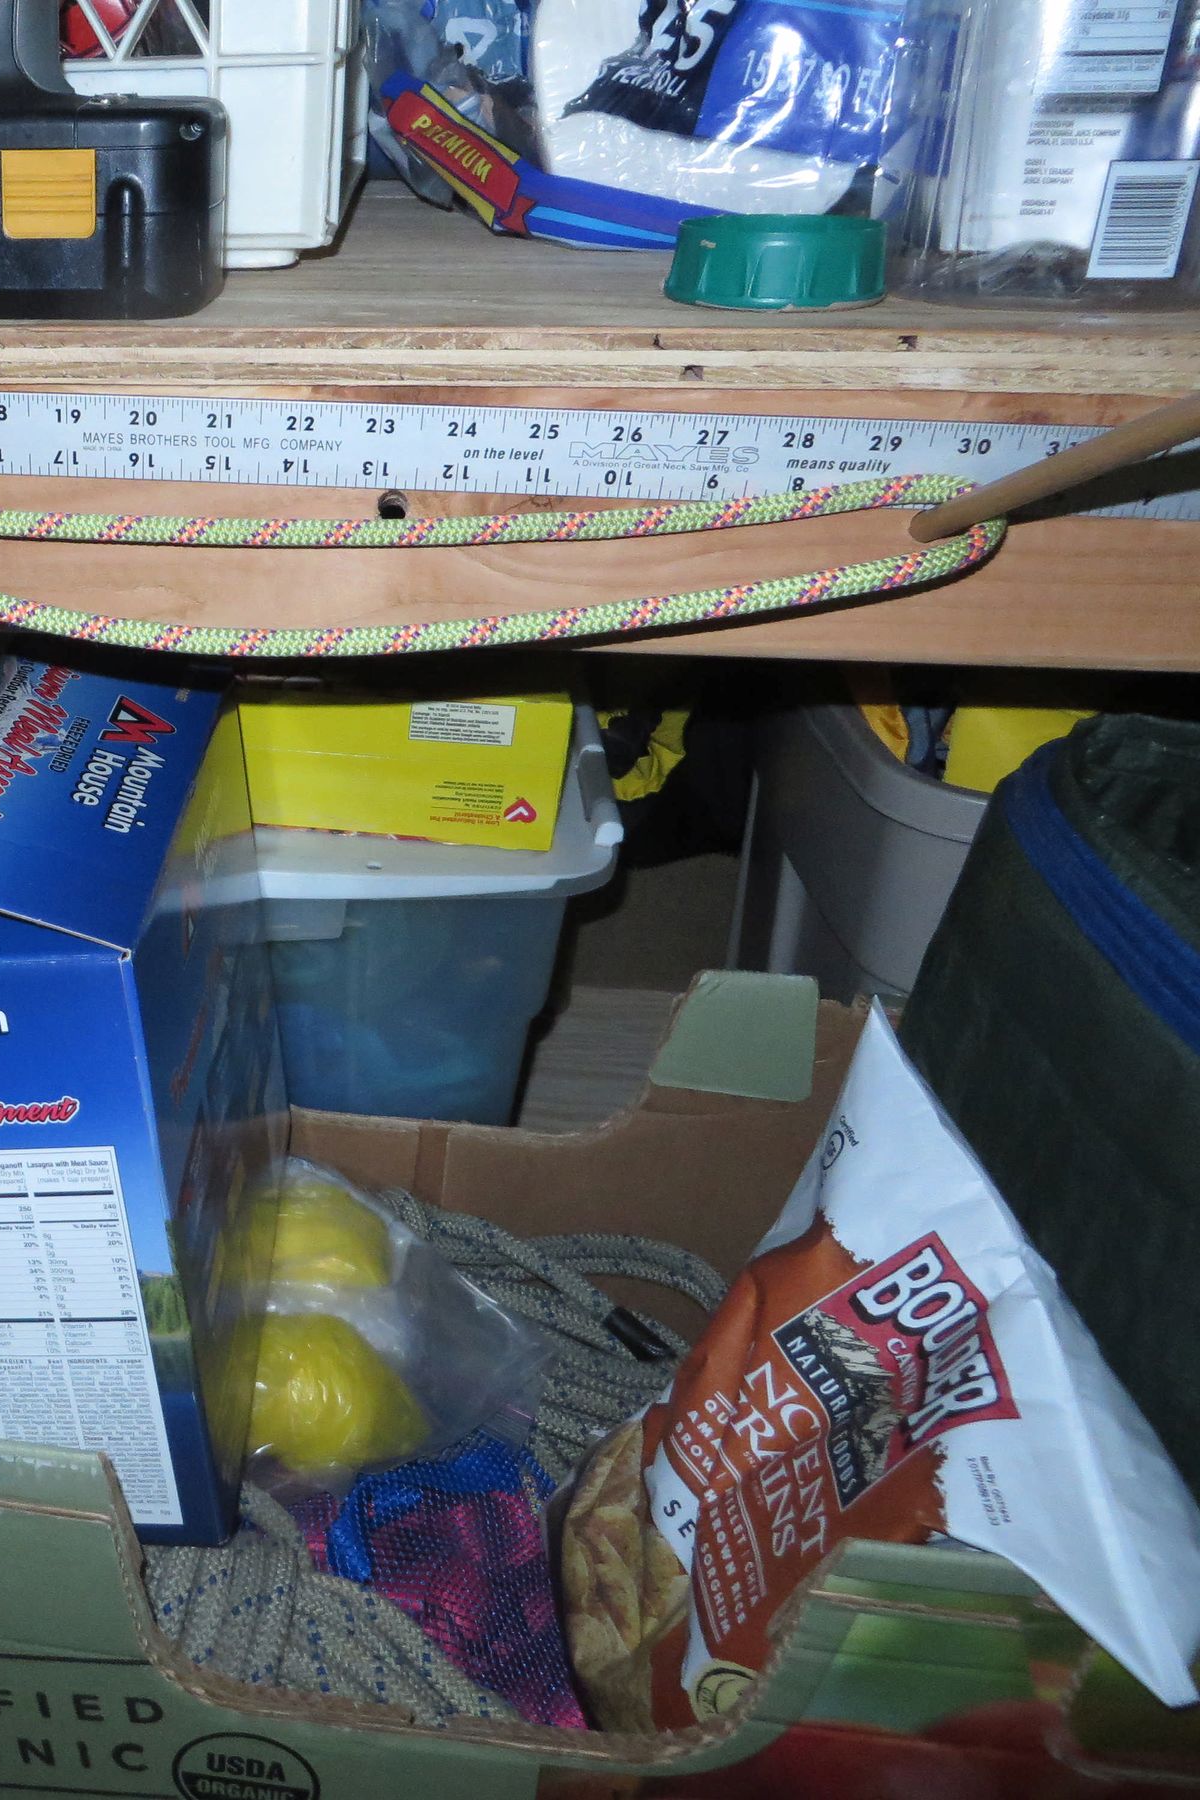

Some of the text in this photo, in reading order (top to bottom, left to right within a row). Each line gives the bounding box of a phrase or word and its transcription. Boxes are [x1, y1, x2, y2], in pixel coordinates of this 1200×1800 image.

[410, 114, 493, 185] PREMIUM
[55, 408, 81, 424] 19
[129, 410, 158, 426] 20
[205, 413, 233, 429] 21
[286, 416, 315, 432] 22
[366, 418, 395, 434] 23
[447, 421, 477, 437] 24
[529, 423, 560, 440] 25
[612, 426, 643, 442] 26
[696, 429, 730, 446] 27
[782, 432, 815, 448] 28
[868, 435, 902, 452] 29
[958, 437, 991, 455] 30
[82, 431, 343, 451] MAYES BROTHERS TOOL MFG COMPANY
[53, 450, 79, 466] 17
[129, 453, 155, 468] 16
[463, 447, 544, 461] on the level
[569, 441, 760, 465] MAYES
[205, 455, 232, 471] 15
[283, 458, 310, 474] 14
[362, 461, 389, 477] 13
[582, 460, 620, 469] Division
[622, 460, 632, 469] of
[634, 461, 661, 470] Great
[662, 462, 687, 471] Neck
[689, 463, 710, 472] Saw
[786, 458, 892, 475] means quality
[443, 464, 470, 480] 12
[525, 467, 551, 483] 11
[604, 470, 633, 486] 10
[792, 476, 805, 491] 8
[3, 699, 70, 757] Meal
[48, 716, 92, 773] FREEZE DRIED
[72, 749, 127, 806] House
[104, 745, 166, 833] Mountain
[26, 1161, 54, 1169] Lasagna
[730, 1388, 796, 1557] RAINS
[662, 1499, 697, 1539] SE
[701, 1542, 731, 1635] SORGHUM
[206, 1751, 287, 1783] USDA
